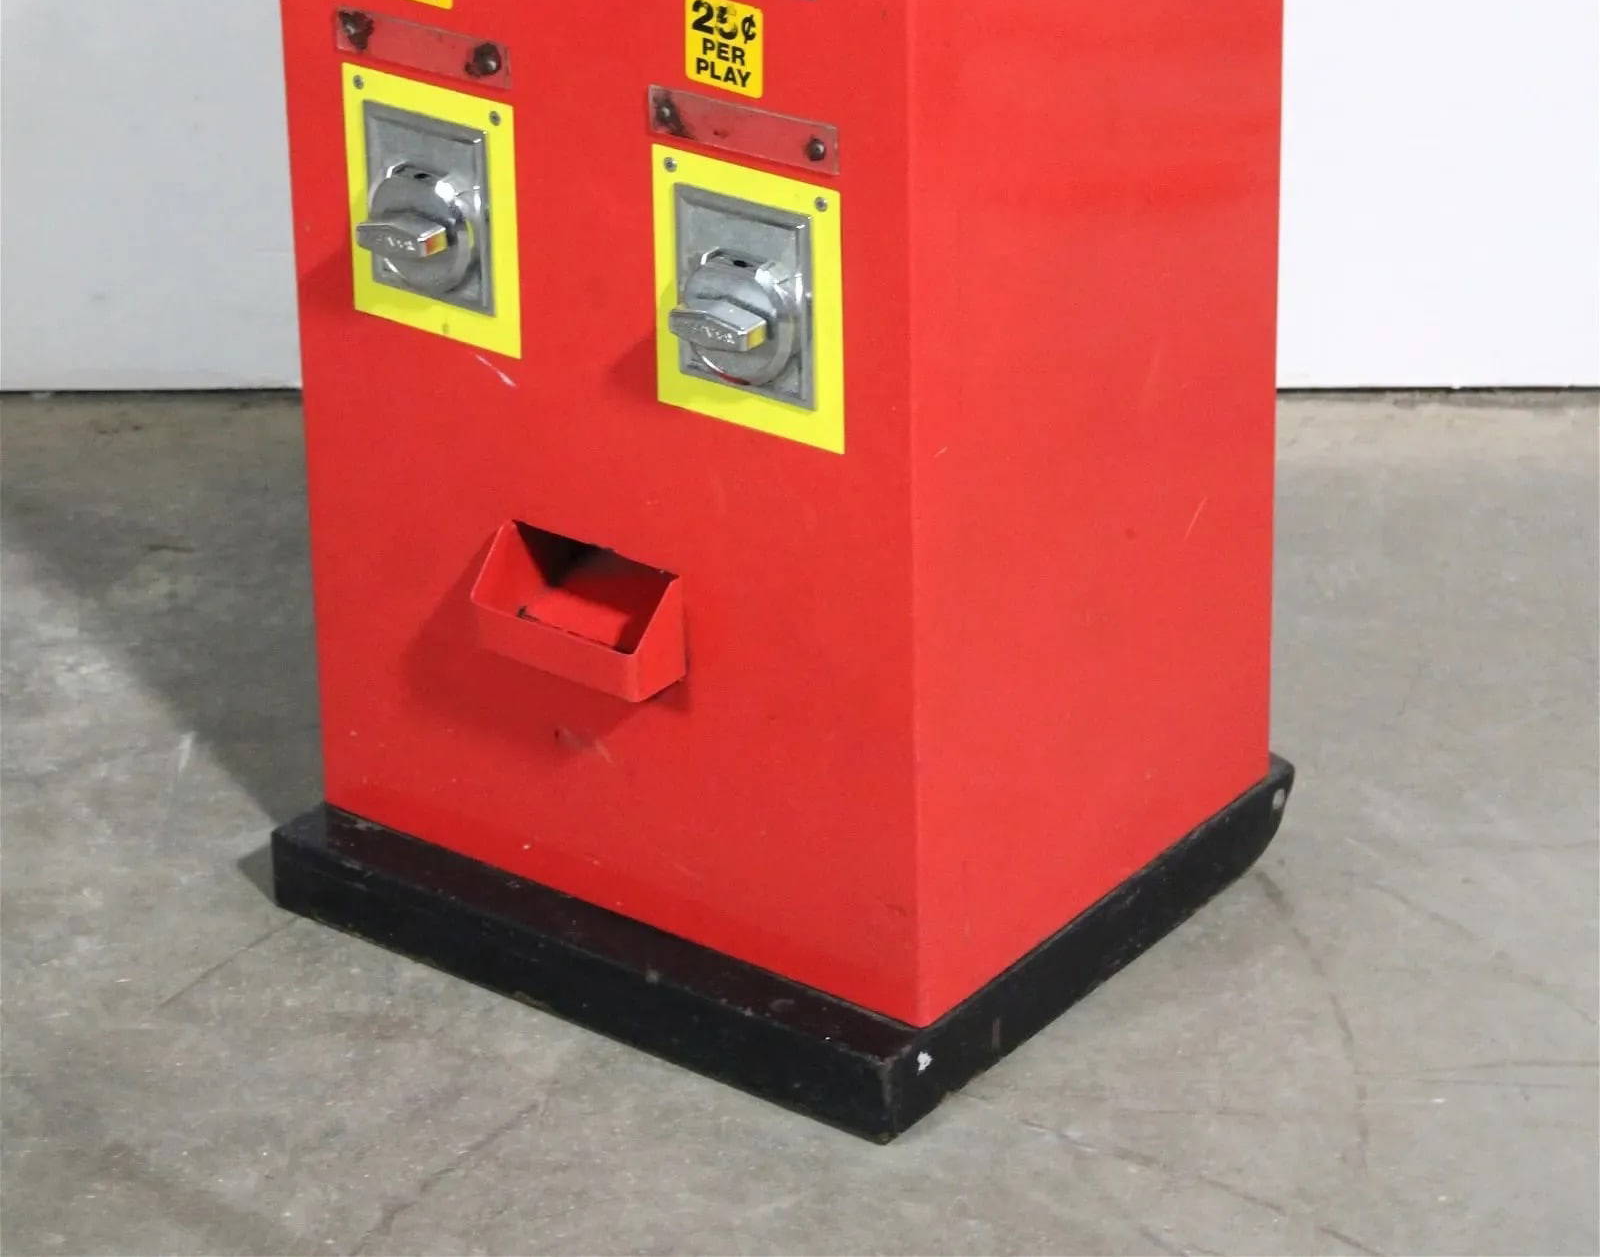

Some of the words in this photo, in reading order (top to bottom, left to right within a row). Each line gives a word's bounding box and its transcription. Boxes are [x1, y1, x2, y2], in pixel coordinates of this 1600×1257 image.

[692, 0, 757, 44] 25¢
[702, 37, 745, 67] PER
[696, 57, 752, 88] PLAY
